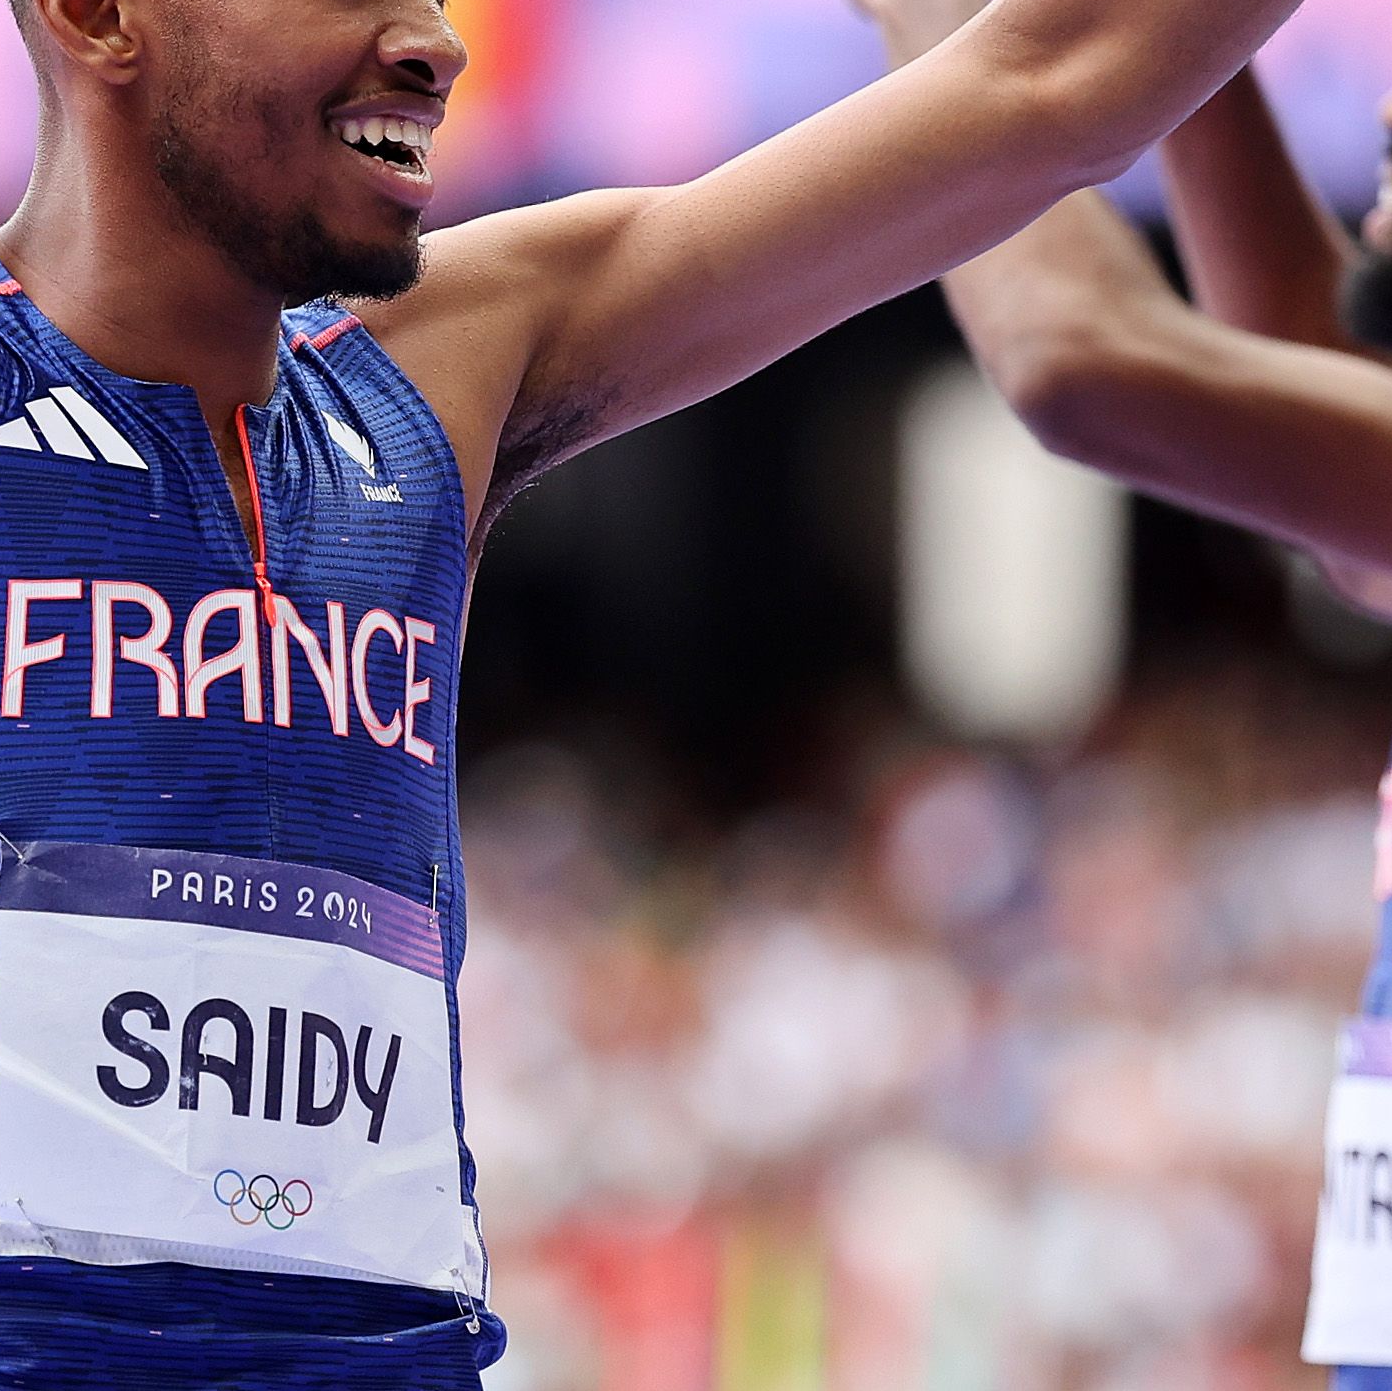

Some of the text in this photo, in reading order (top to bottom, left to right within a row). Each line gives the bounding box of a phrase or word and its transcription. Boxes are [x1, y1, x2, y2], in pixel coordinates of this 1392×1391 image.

[359, 482, 403, 503] FRANCE
[0, 578, 437, 766] FRANCE
[295, 886, 372, 934] 2024
[96, 991, 402, 1145] SAIDY
